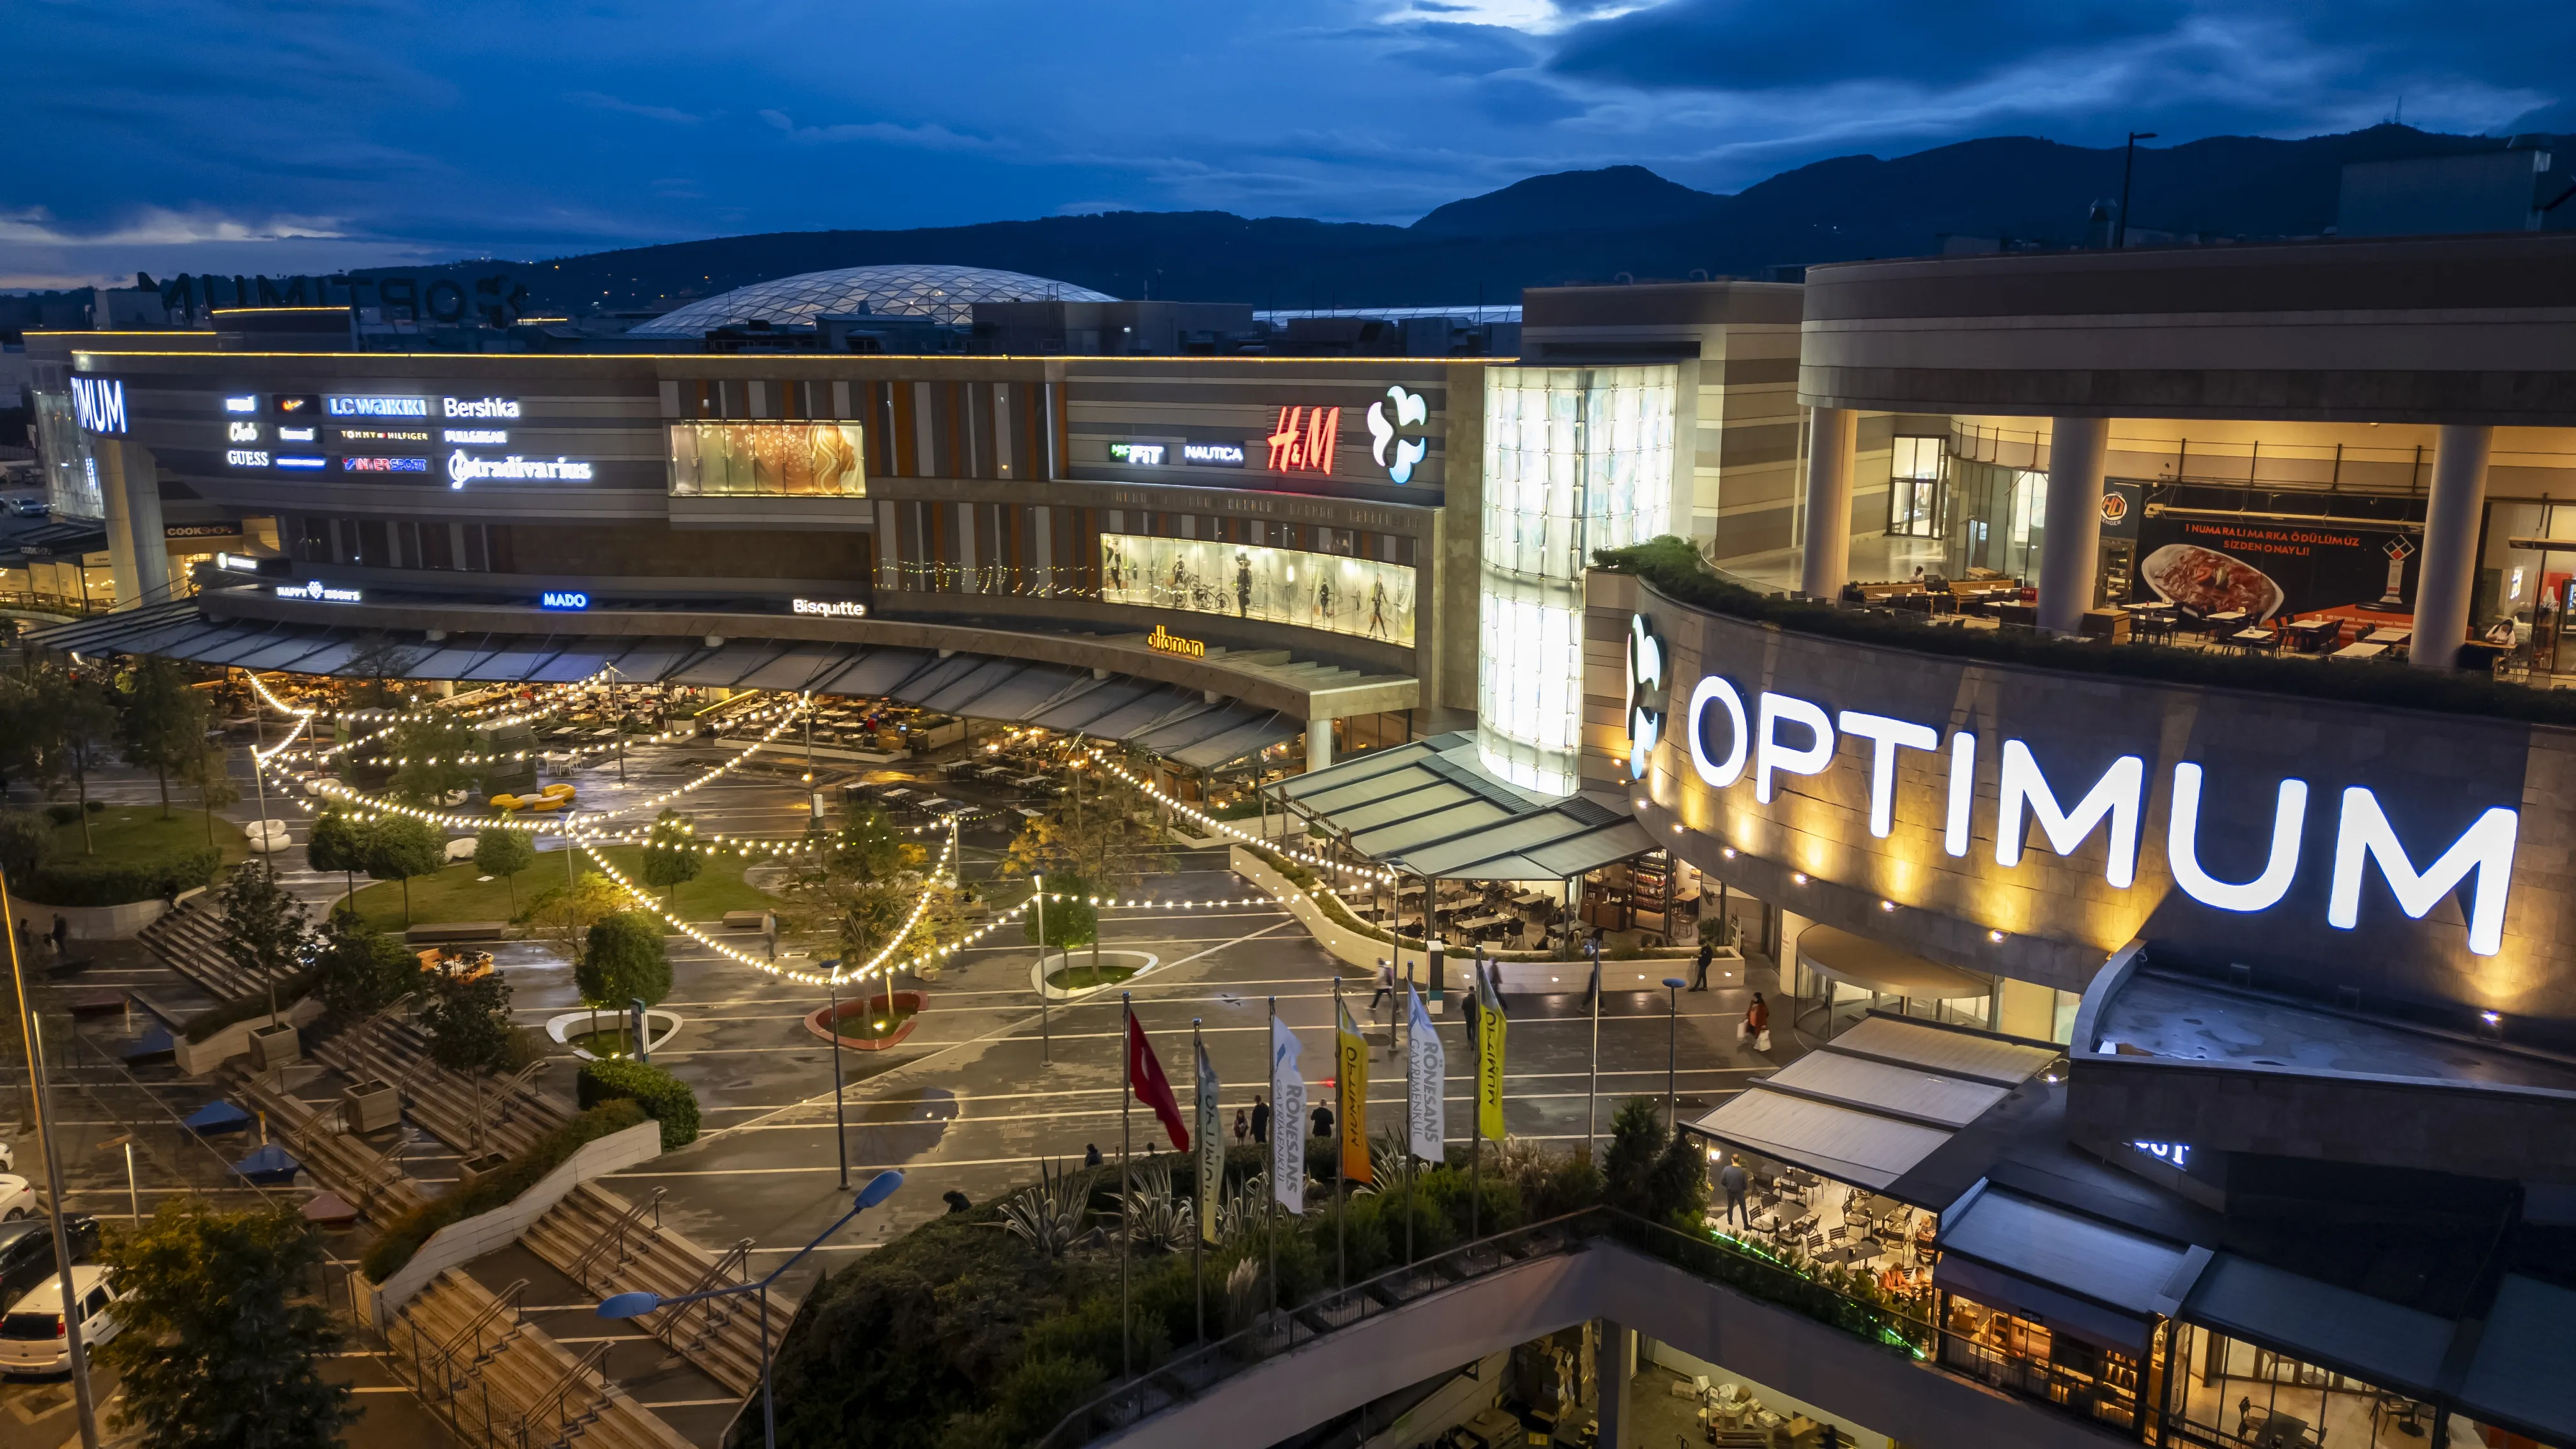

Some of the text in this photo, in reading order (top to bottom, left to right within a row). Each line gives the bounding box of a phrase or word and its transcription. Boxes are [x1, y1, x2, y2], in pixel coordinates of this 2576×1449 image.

[443, 397, 520, 417] Bershka
[341, 430, 429, 440] TOMMY HILFIGER
[1266, 405, 1340, 475] H&M
[227, 450, 269, 466] GUESS
[1184, 445, 1245, 462] NAUTICA
[544, 593, 586, 608] MADO
[792, 599, 864, 617] Bisquitte
[1688, 675, 2519, 956] OPTIMUM
[1422, 1040, 1444, 1144] RÖNESANS
[1285, 1084, 1306, 1193] RÖNESANS
